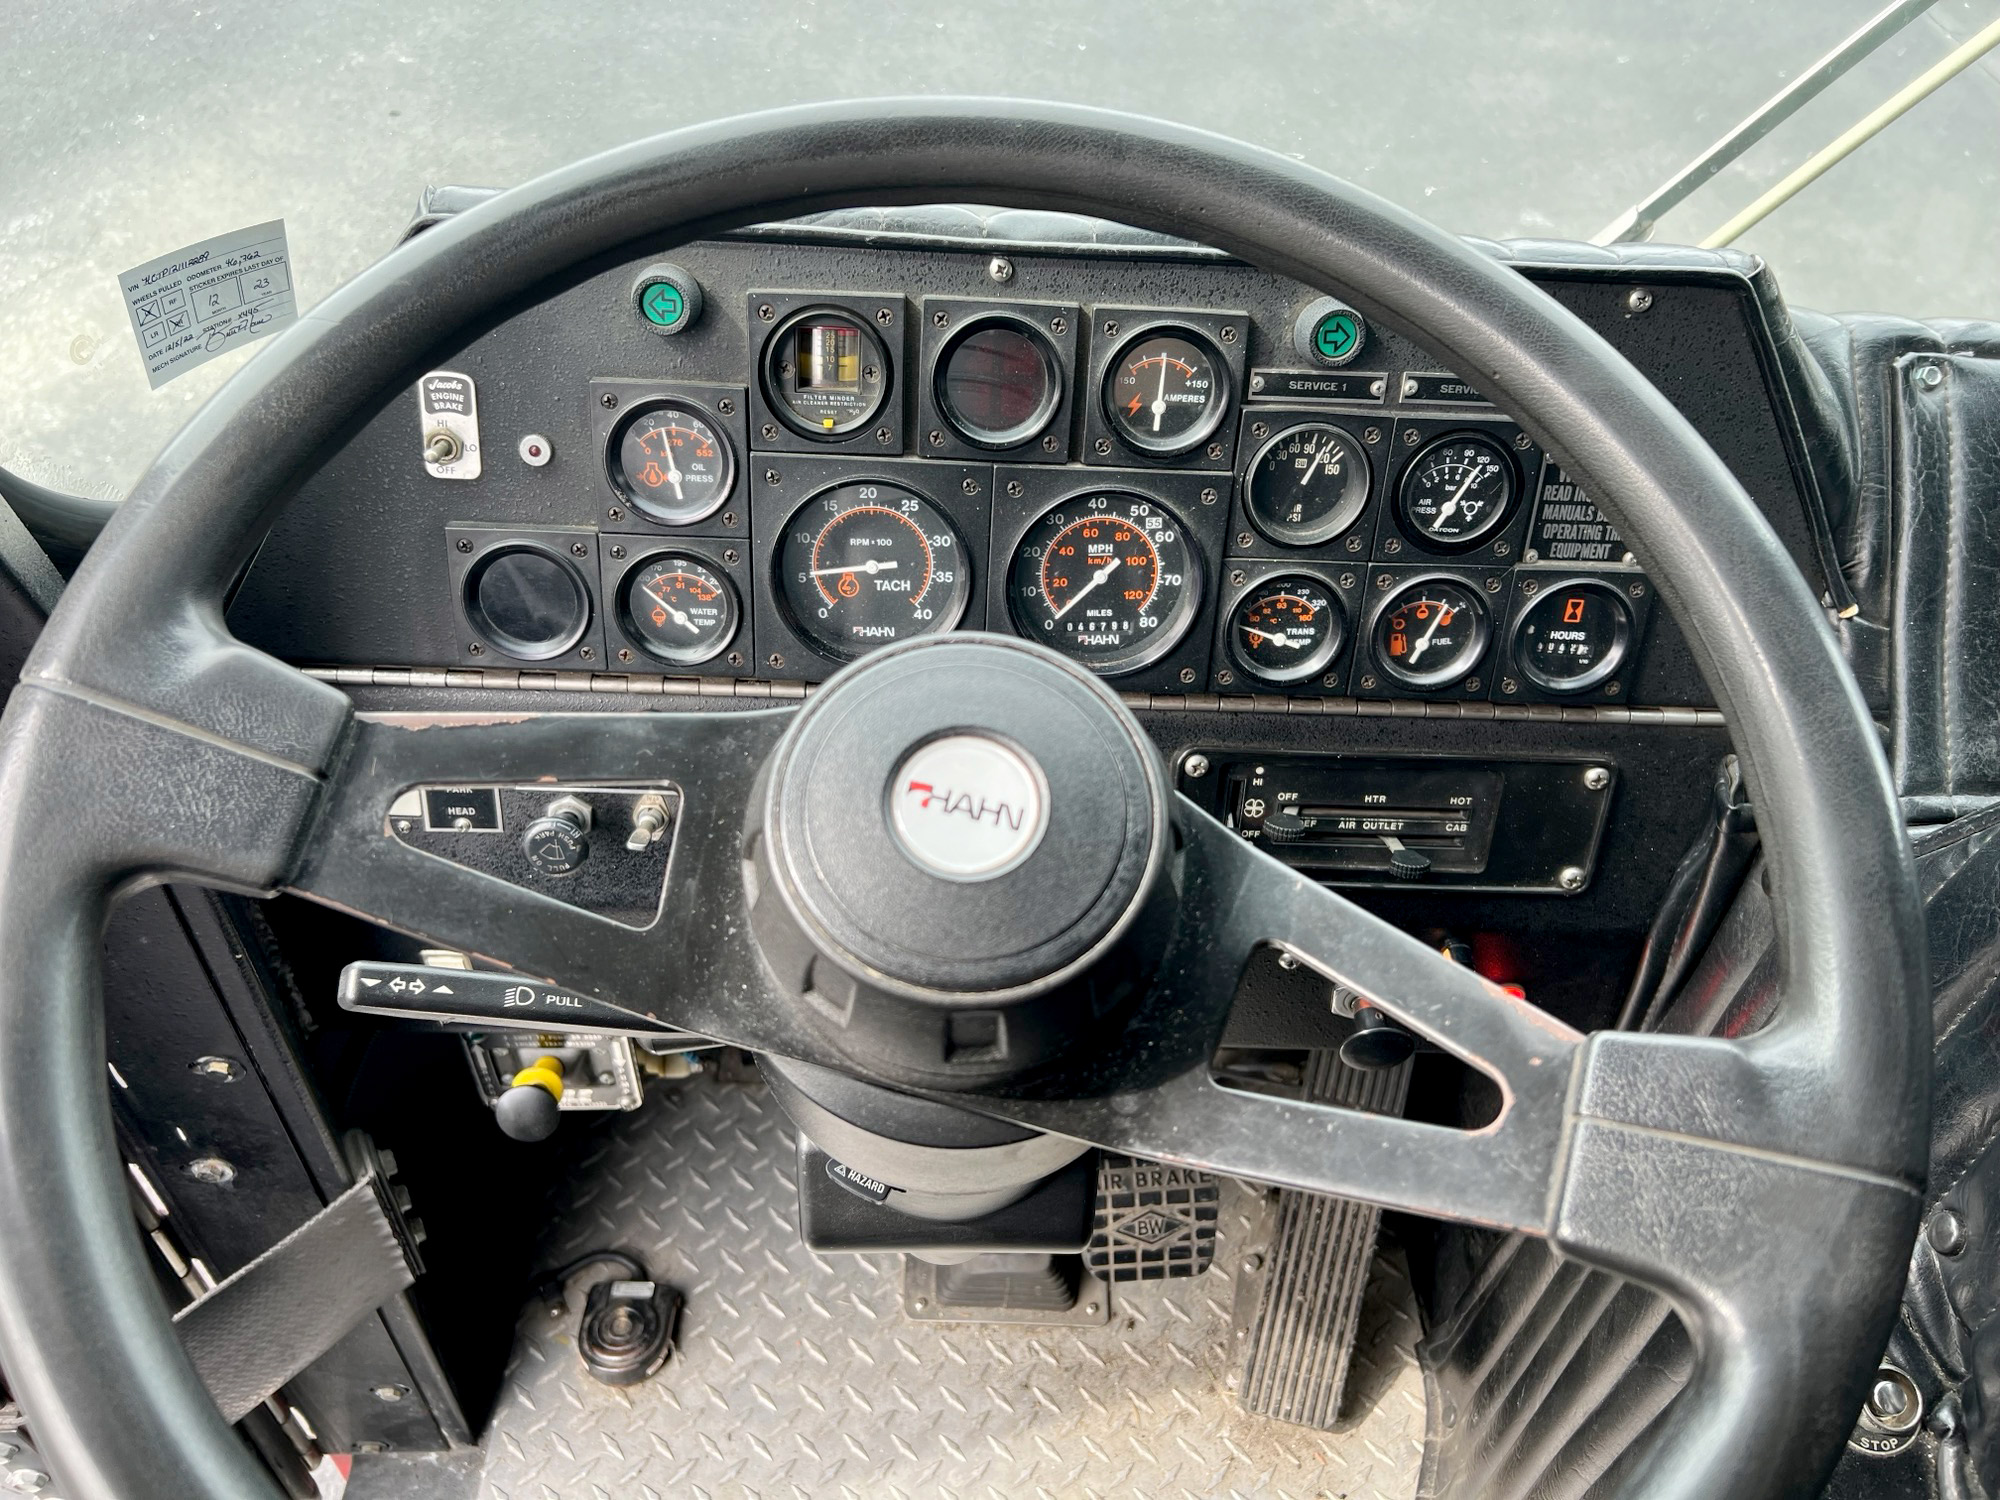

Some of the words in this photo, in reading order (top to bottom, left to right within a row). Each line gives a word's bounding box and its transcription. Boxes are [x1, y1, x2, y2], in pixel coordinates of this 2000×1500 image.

[186, 265, 222, 282] ODOMETER
[188, 279, 217, 292] STICKER
[216, 268, 244, 281] EXPIRES
[244, 262, 260, 272] LAST
[261, 258, 275, 267] DAY
[128, 284, 140, 293] VIN
[253, 277, 270, 290] 23
[132, 290, 158, 306] WHEELS
[158, 280, 182, 294] PULLED
[208, 293, 220, 307] 12
[148, 350, 164, 361] DATE
[152, 360, 170, 374] MECH
[169, 343, 203, 364] SIGNATURE
[428, 378, 463, 391] Jacobs
[1185, 380, 1208, 389] +150
[1288, 380, 1339, 392] SERVICE
[1341, 383, 1347, 392] 1
[1439, 384, 1480, 395] SERVI
[430, 391, 465, 403] ENGINE
[1163, 393, 1205, 404] AMPERES
[433, 401, 463, 412] BRAKE
[667, 411, 680, 419] 40
[437, 419, 448, 428] HI
[464, 443, 478, 453] LO
[696, 449, 713, 458] 552
[1290, 443, 1300, 453] 60
[1304, 443, 1315, 453] 90
[1276, 450, 1287, 460] 30
[436, 465, 456, 475] OFF
[691, 463, 706, 471] OIL
[1269, 461, 1275, 470] 0
[1325, 463, 1340, 474] 150
[685, 474, 714, 483] PRESS
[1445, 483, 1457, 491] bar
[859, 487, 877, 499] 20
[1543, 485, 1573, 502] READ
[822, 501, 838, 511] 15
[901, 500, 919, 511] 25
[1088, 497, 1107, 509] 40
[1418, 498, 1432, 506] AIR
[1130, 505, 1149, 517] 50
[1542, 504, 1595, 522] MANUALS
[1046, 514, 1064, 525] 30
[1147, 518, 1161, 527] 55
[1083, 528, 1099, 538] 60
[1115, 531, 1130, 542] 80
[1155, 531, 1174, 543] 60
[1542, 523, 1603, 541] OPERATING
[795, 533, 811, 543] 10
[932, 535, 951, 547] 30
[1023, 546, 1041, 558] 20
[1059, 546, 1075, 556] 40
[1088, 544, 1113, 553] MPH
[1549, 542, 1612, 560] EQUIPMENT
[1126, 556, 1147, 566] 100
[798, 573, 807, 583] 5
[936, 572, 953, 583] 35
[1053, 578, 1068, 588] 20
[1165, 574, 1182, 586] 70
[675, 582, 685, 590] 91
[874, 580, 911, 591] TACH
[1022, 586, 1037, 597] 10
[1123, 589, 1144, 599] 120
[1311, 599, 1327, 607] 320
[690, 608, 718, 616] WATER
[818, 607, 828, 618] 0
[913, 608, 932, 620] 40
[1086, 609, 1113, 617] MILES
[1045, 620, 1054, 630] 0
[1139, 616, 1158, 628] 80
[1286, 627, 1315, 635] TRANS
[1550, 630, 1586, 641] HOURS
[1431, 637, 1452, 646] FUEL
[1252, 778, 1263, 786] HI
[1278, 792, 1299, 801] OFF
[1364, 795, 1387, 803] HTR
[1450, 797, 1473, 805] HOT
[447, 806, 476, 816] HEAD
[1338, 821, 1356, 829] AIR
[1363, 821, 1404, 831] OUTLET
[1445, 823, 1468, 832] CAB
[534, 830, 555, 841] PARK
[1242, 829, 1261, 838] OFF
[547, 862, 571, 872] PULL
[546, 994, 583, 1008] PULL
[847, 1169, 886, 1194] HAZARD
[1097, 1173, 1122, 1190] IR
[1135, 1166, 1212, 1188] BRAKE
[1138, 1219, 1163, 1236] BW
[1860, 1437, 1899, 1451] STOP
